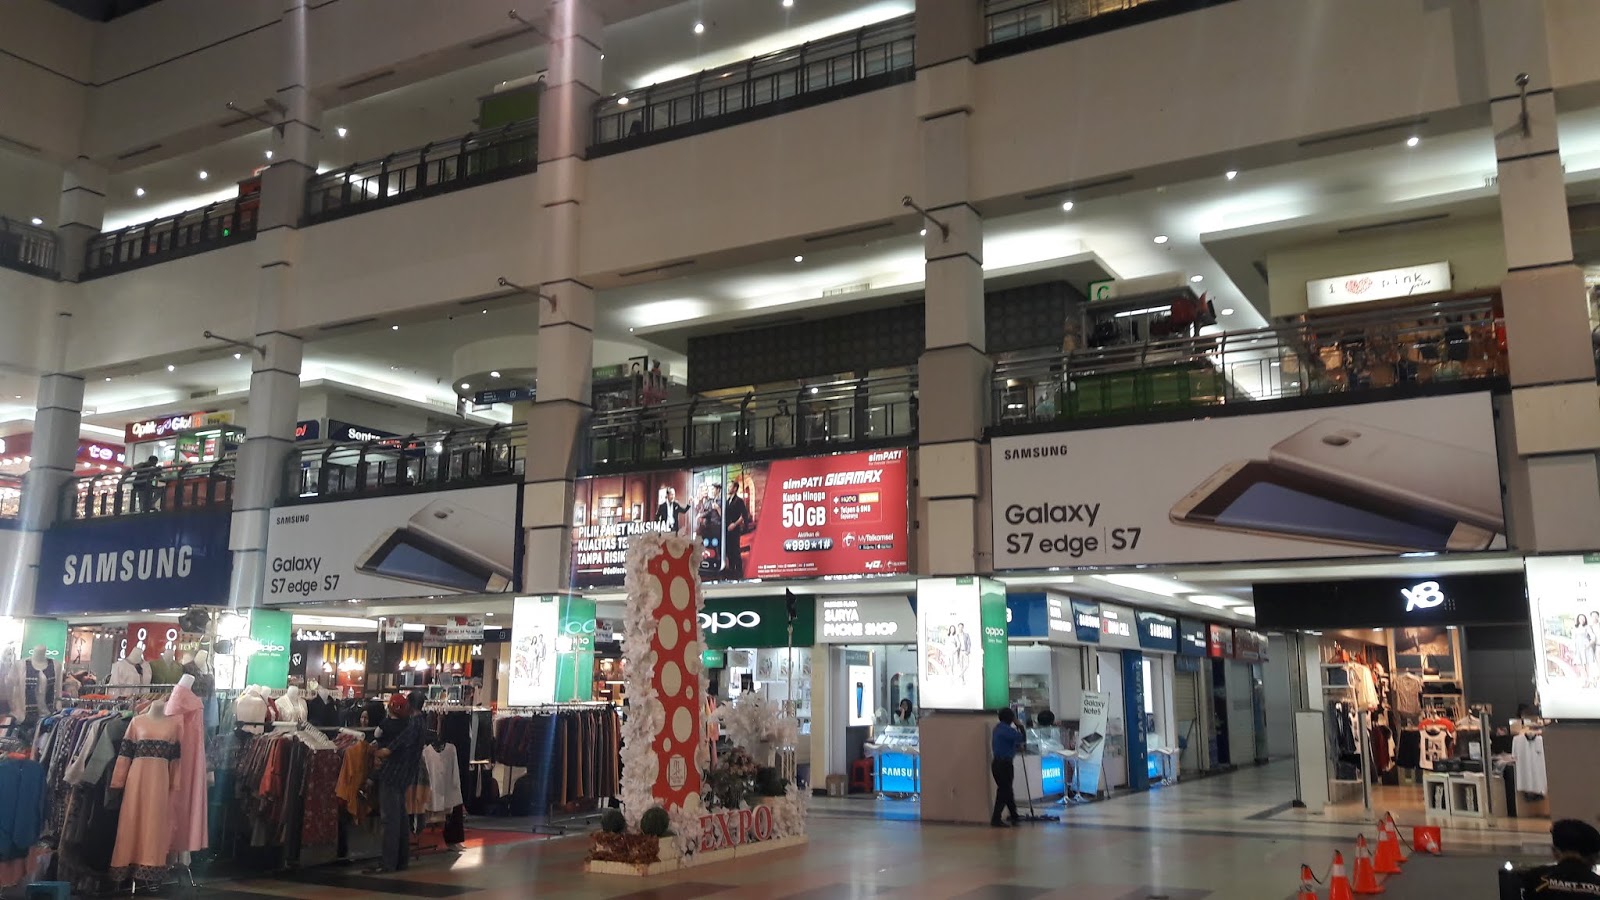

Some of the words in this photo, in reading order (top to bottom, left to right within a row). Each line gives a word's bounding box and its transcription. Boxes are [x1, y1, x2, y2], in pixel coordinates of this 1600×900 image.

[1004, 445, 1068, 460] SAMSUNG
[824, 469, 883, 487] GIGAMAX
[276, 514, 310, 525] SAMSUNG
[782, 502, 805, 528] 50
[806, 506, 826, 527] GB
[1005, 502, 1101, 527] Galaxy
[578, 524, 600, 538] PILIH
[600, 522, 627, 537] PAKET
[577, 536, 617, 551] KUALITAS
[1006, 532, 1034, 554] S7
[1039, 534, 1099, 558] edge
[1111, 527, 1142, 550] S7
[62, 545, 193, 586] SAMSUNG
[272, 557, 322, 573] Galaxy
[577, 552, 603, 565] TANPA
[604, 550, 628, 564] RISIK
[270, 578, 286, 594] S7
[287, 577, 318, 596] edge
[323, 575, 340, 591] S7
[697, 610, 761, 634] ppo
[824, 608, 860, 622] SURYA
[823, 622, 863, 636] PHONE
[864, 621, 898, 636] SHOP
[985, 626, 1004, 637] oppo
[881, 767, 919, 777] SAMSU
[698, 805, 773, 853] EXPO
